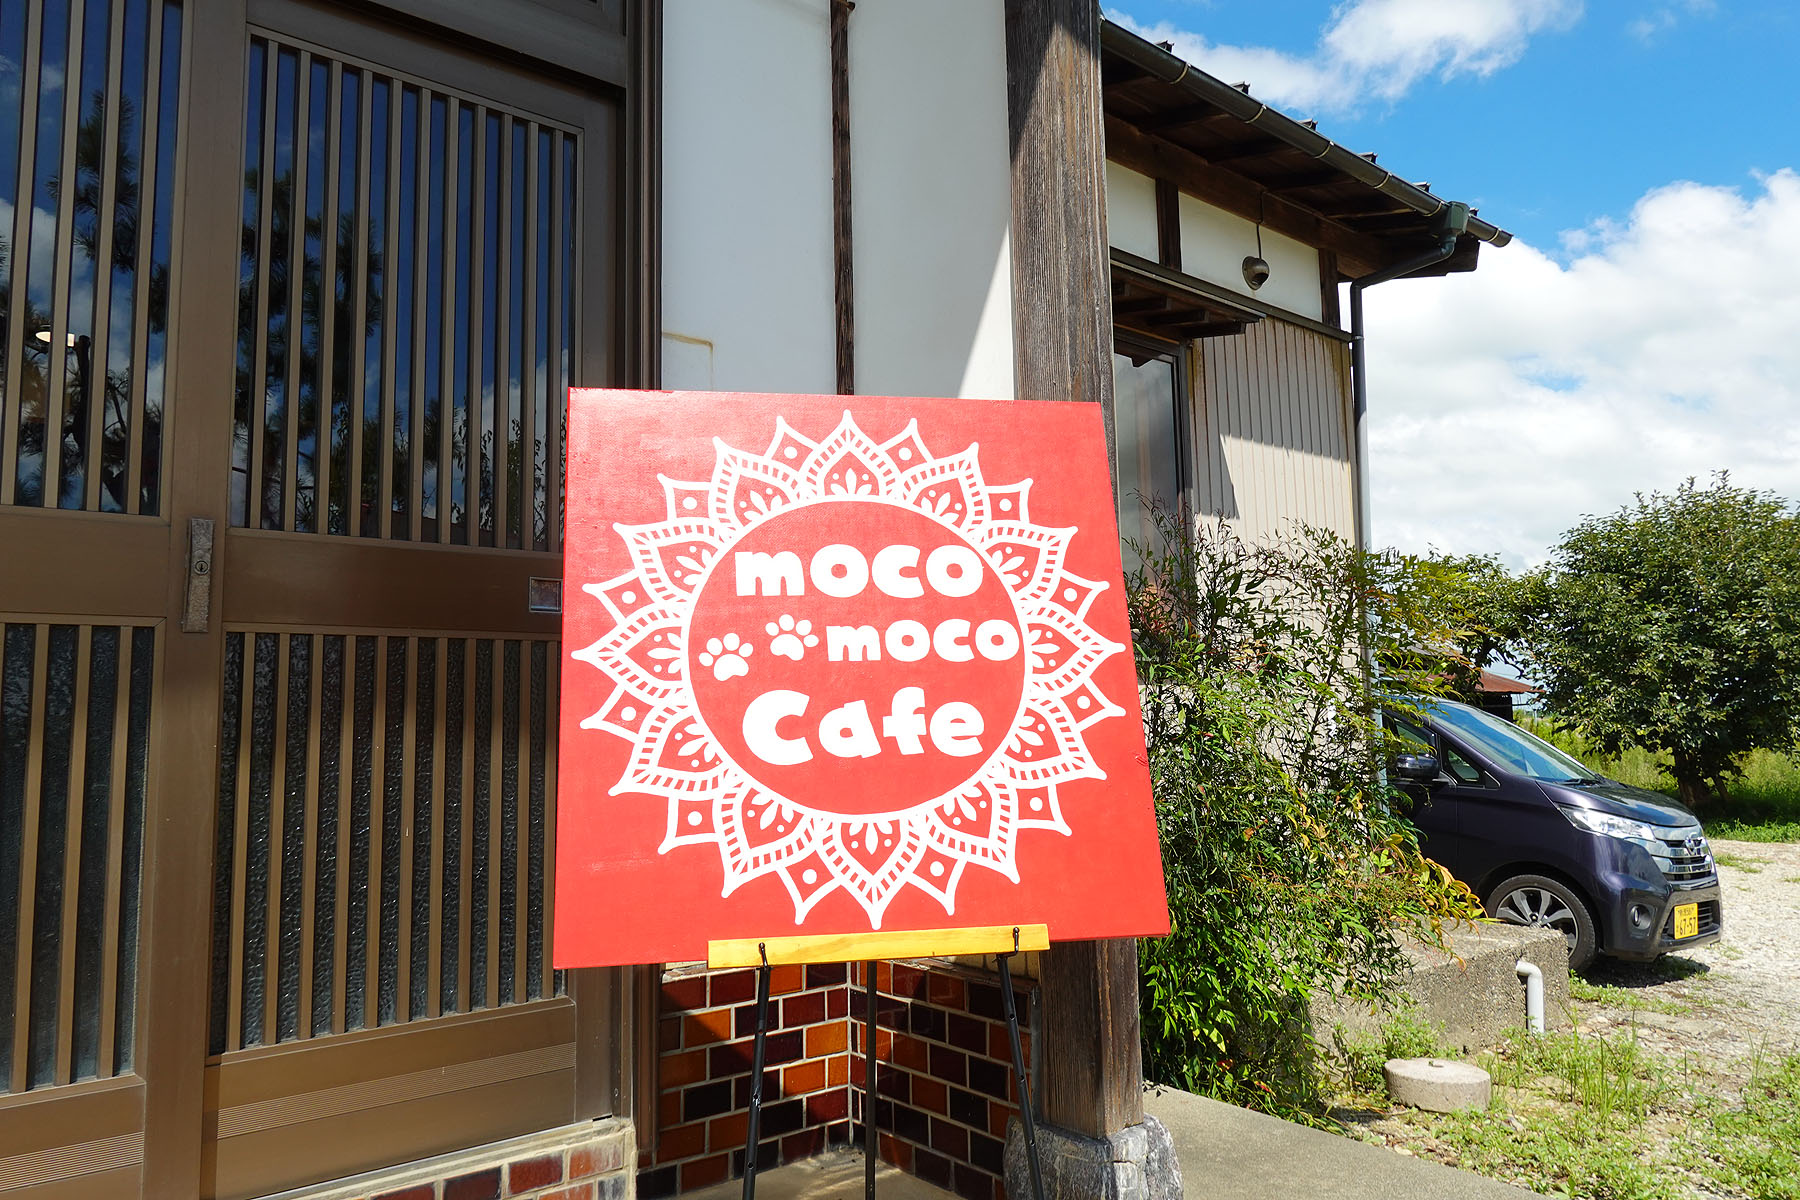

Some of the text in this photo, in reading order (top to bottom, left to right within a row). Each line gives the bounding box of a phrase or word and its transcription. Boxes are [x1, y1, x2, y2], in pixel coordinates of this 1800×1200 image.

[735, 544, 984, 598] moco
[826, 619, 1020, 662] moco
[742, 687, 985, 766] Cafe
